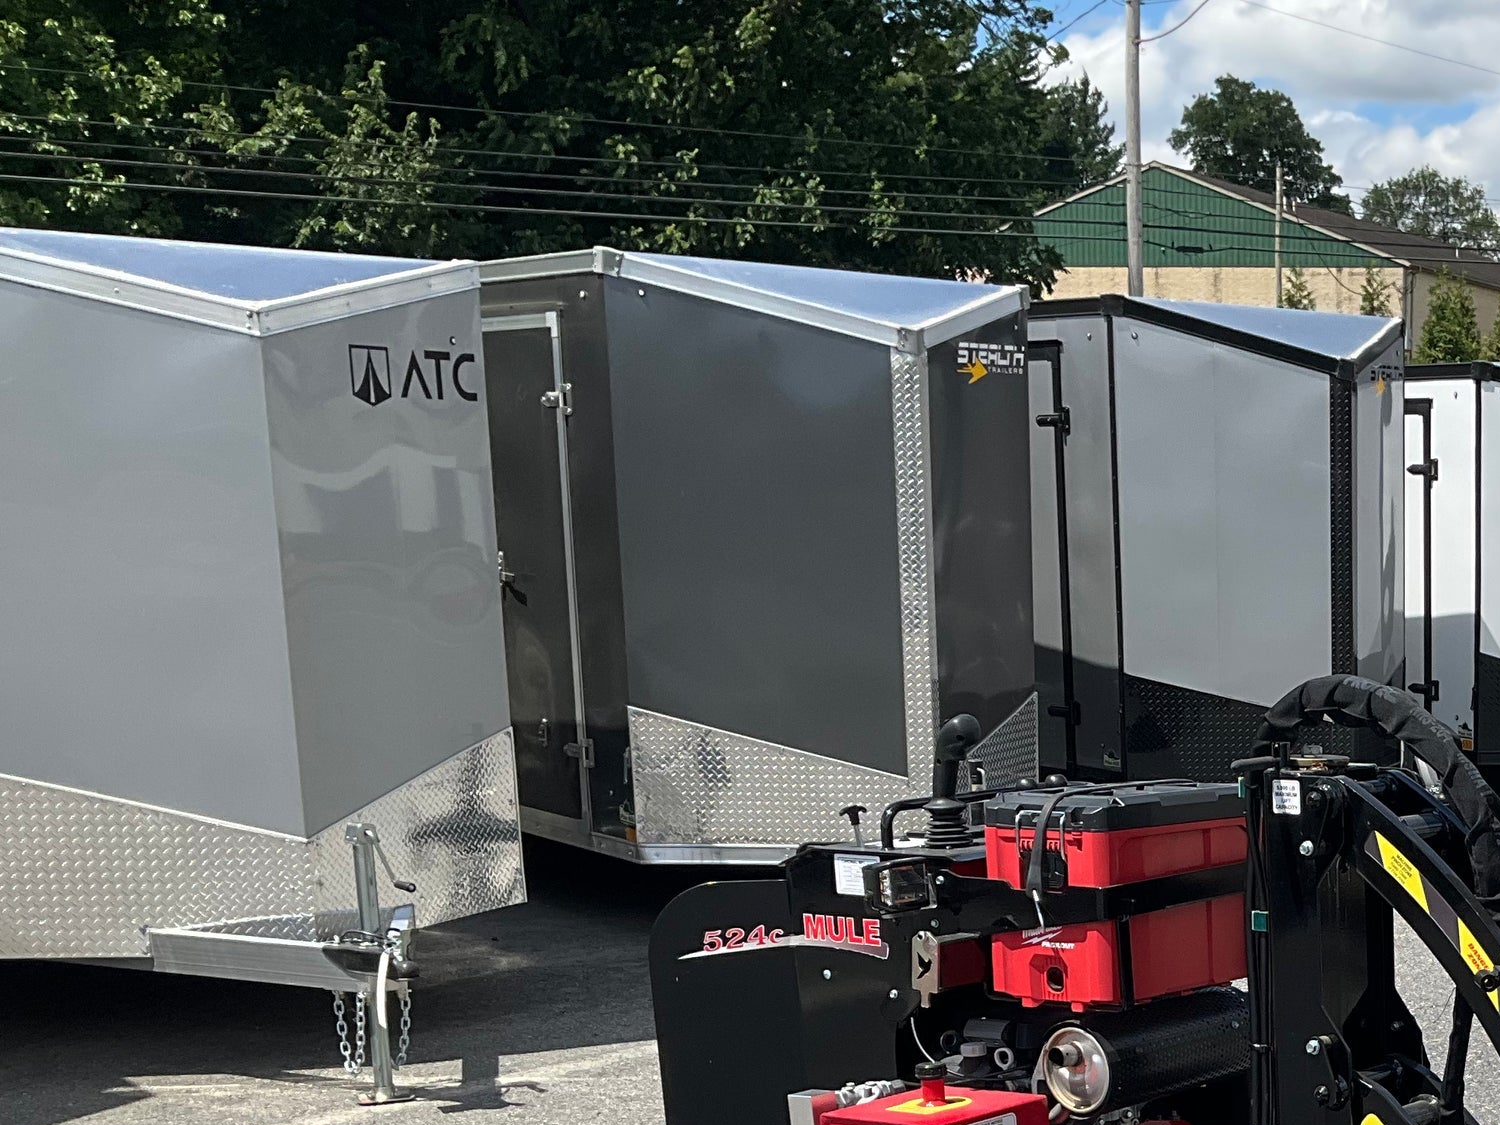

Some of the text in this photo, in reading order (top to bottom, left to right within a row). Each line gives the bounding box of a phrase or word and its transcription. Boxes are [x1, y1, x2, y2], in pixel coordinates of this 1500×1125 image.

[400, 349, 479, 402] ATC
[802, 912, 882, 947] MULE
[1467, 942, 1490, 970] DANGE
